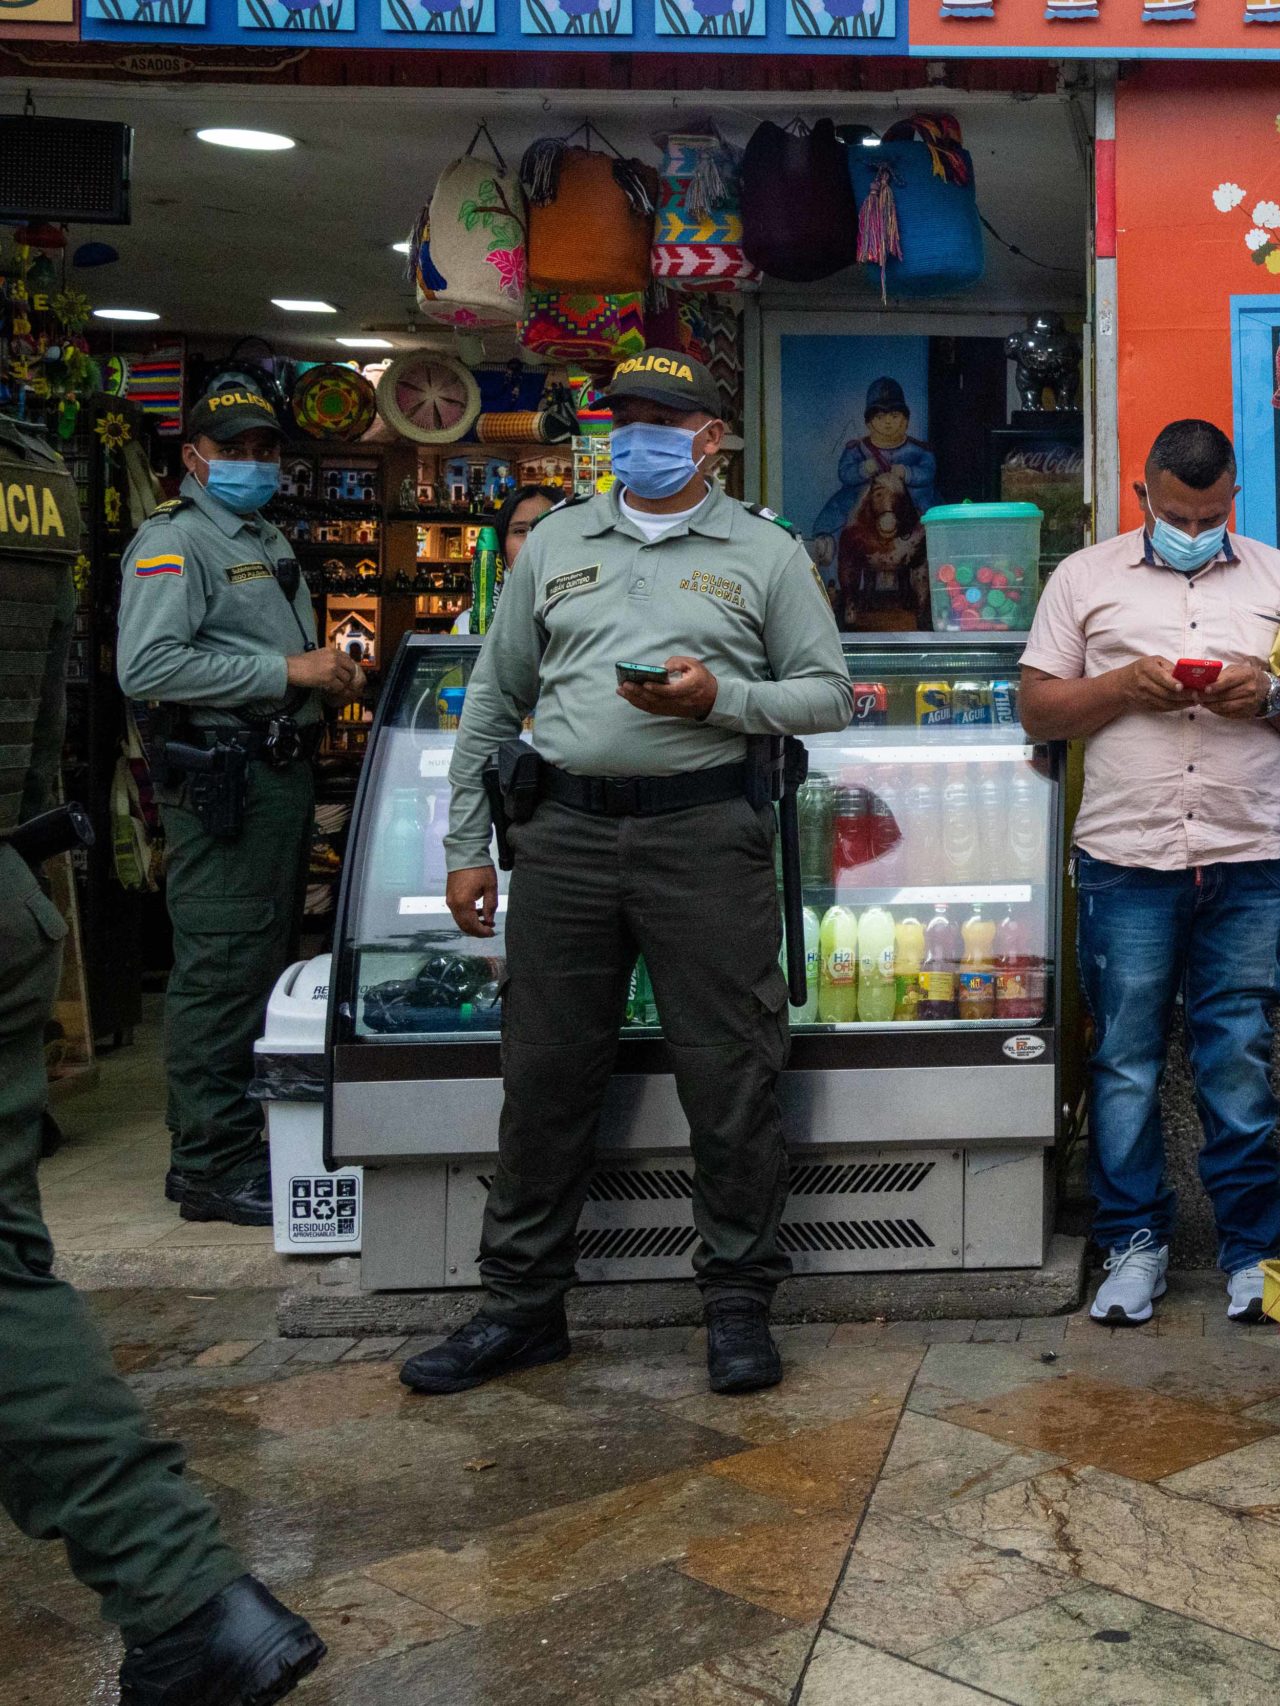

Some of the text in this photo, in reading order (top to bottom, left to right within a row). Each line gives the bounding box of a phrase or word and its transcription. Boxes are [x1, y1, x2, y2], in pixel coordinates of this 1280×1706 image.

[131, 57, 181, 71] ASADOS
[612, 355, 694, 382] POLICIA
[680, 579, 746, 608] NACIONAL
[692, 570, 742, 594] POLICIA
[292, 1222, 336, 1232] RESIDUOS
